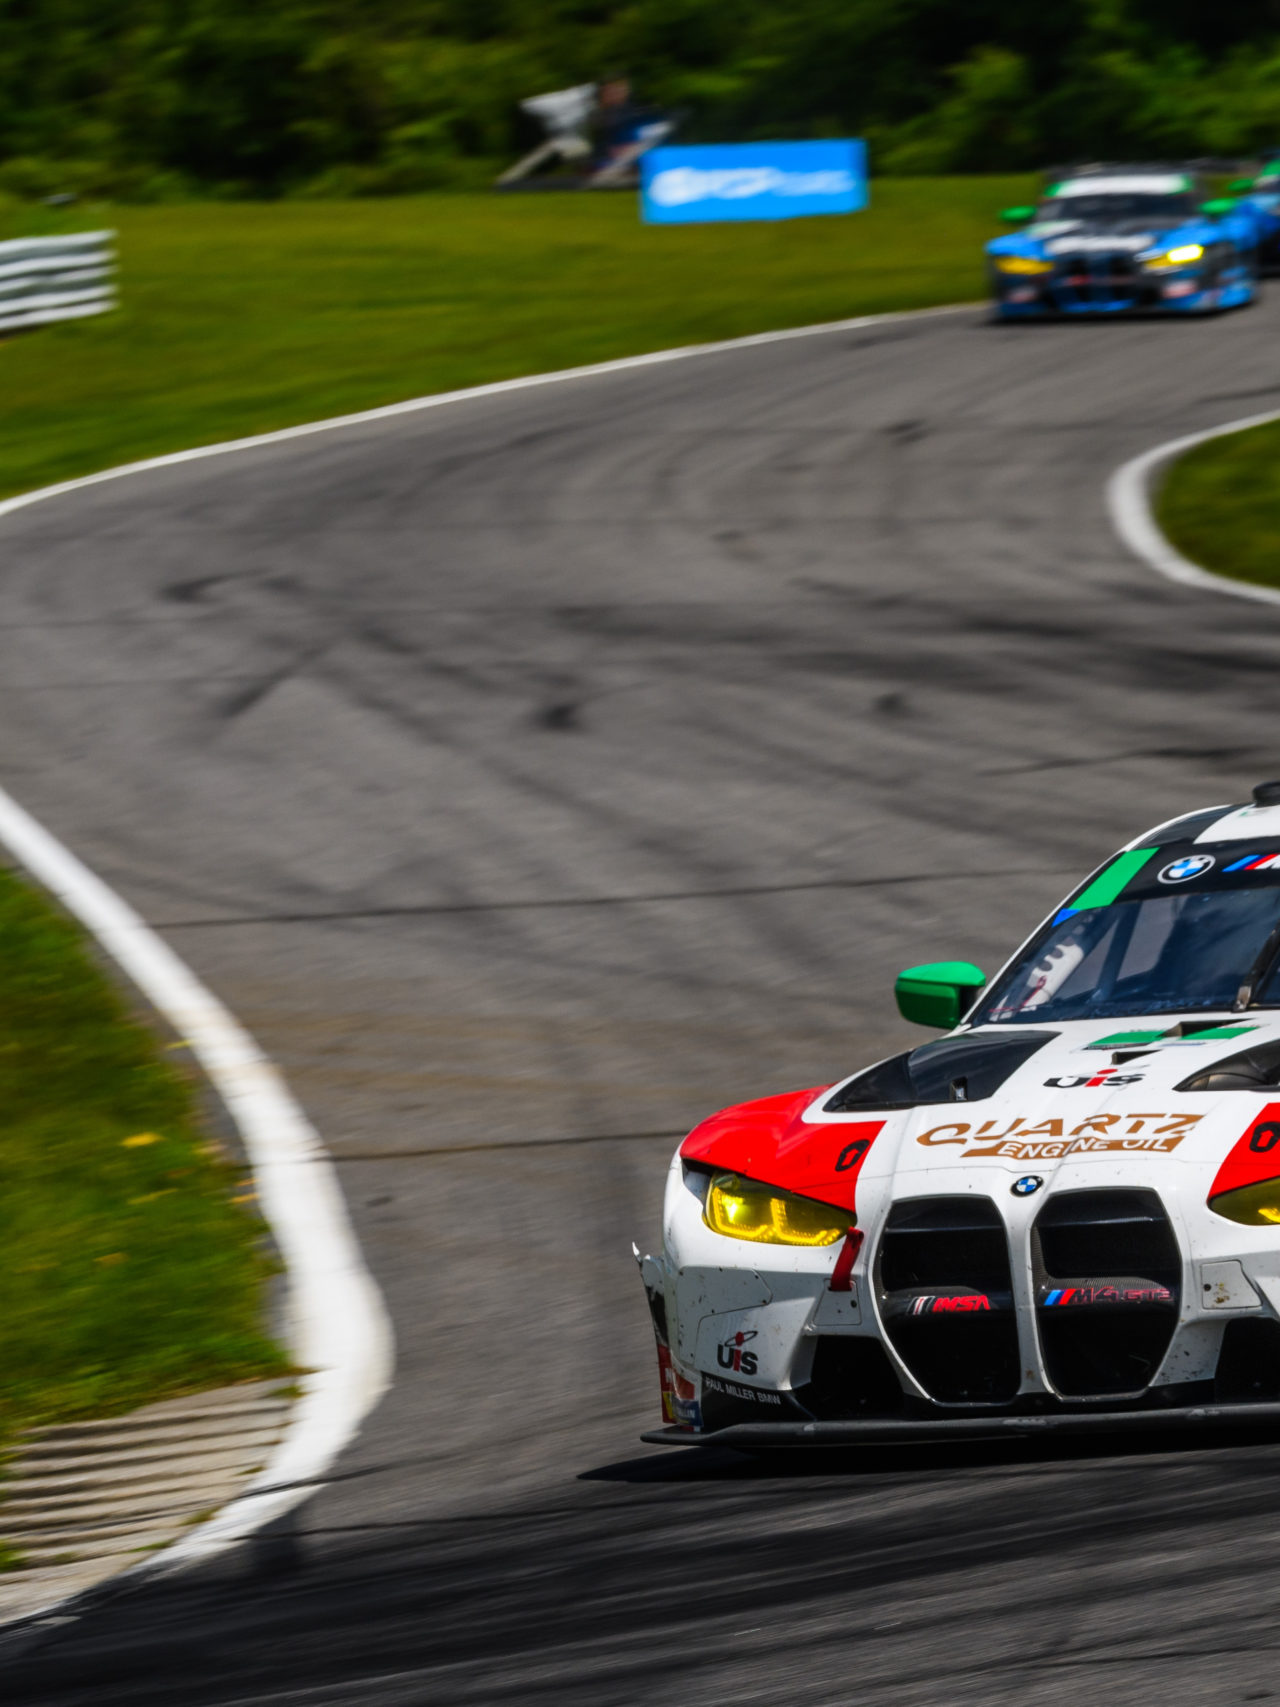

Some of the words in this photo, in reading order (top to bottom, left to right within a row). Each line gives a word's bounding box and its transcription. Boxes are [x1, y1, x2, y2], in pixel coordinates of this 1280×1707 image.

[916, 1113, 1205, 1147] QUARTZ
[997, 1138, 1110, 1158] ENGINE
[932, 1294, 991, 1313] IMSA
[705, 1377, 723, 1392] PAUL
[725, 1383, 756, 1401] MILLER
